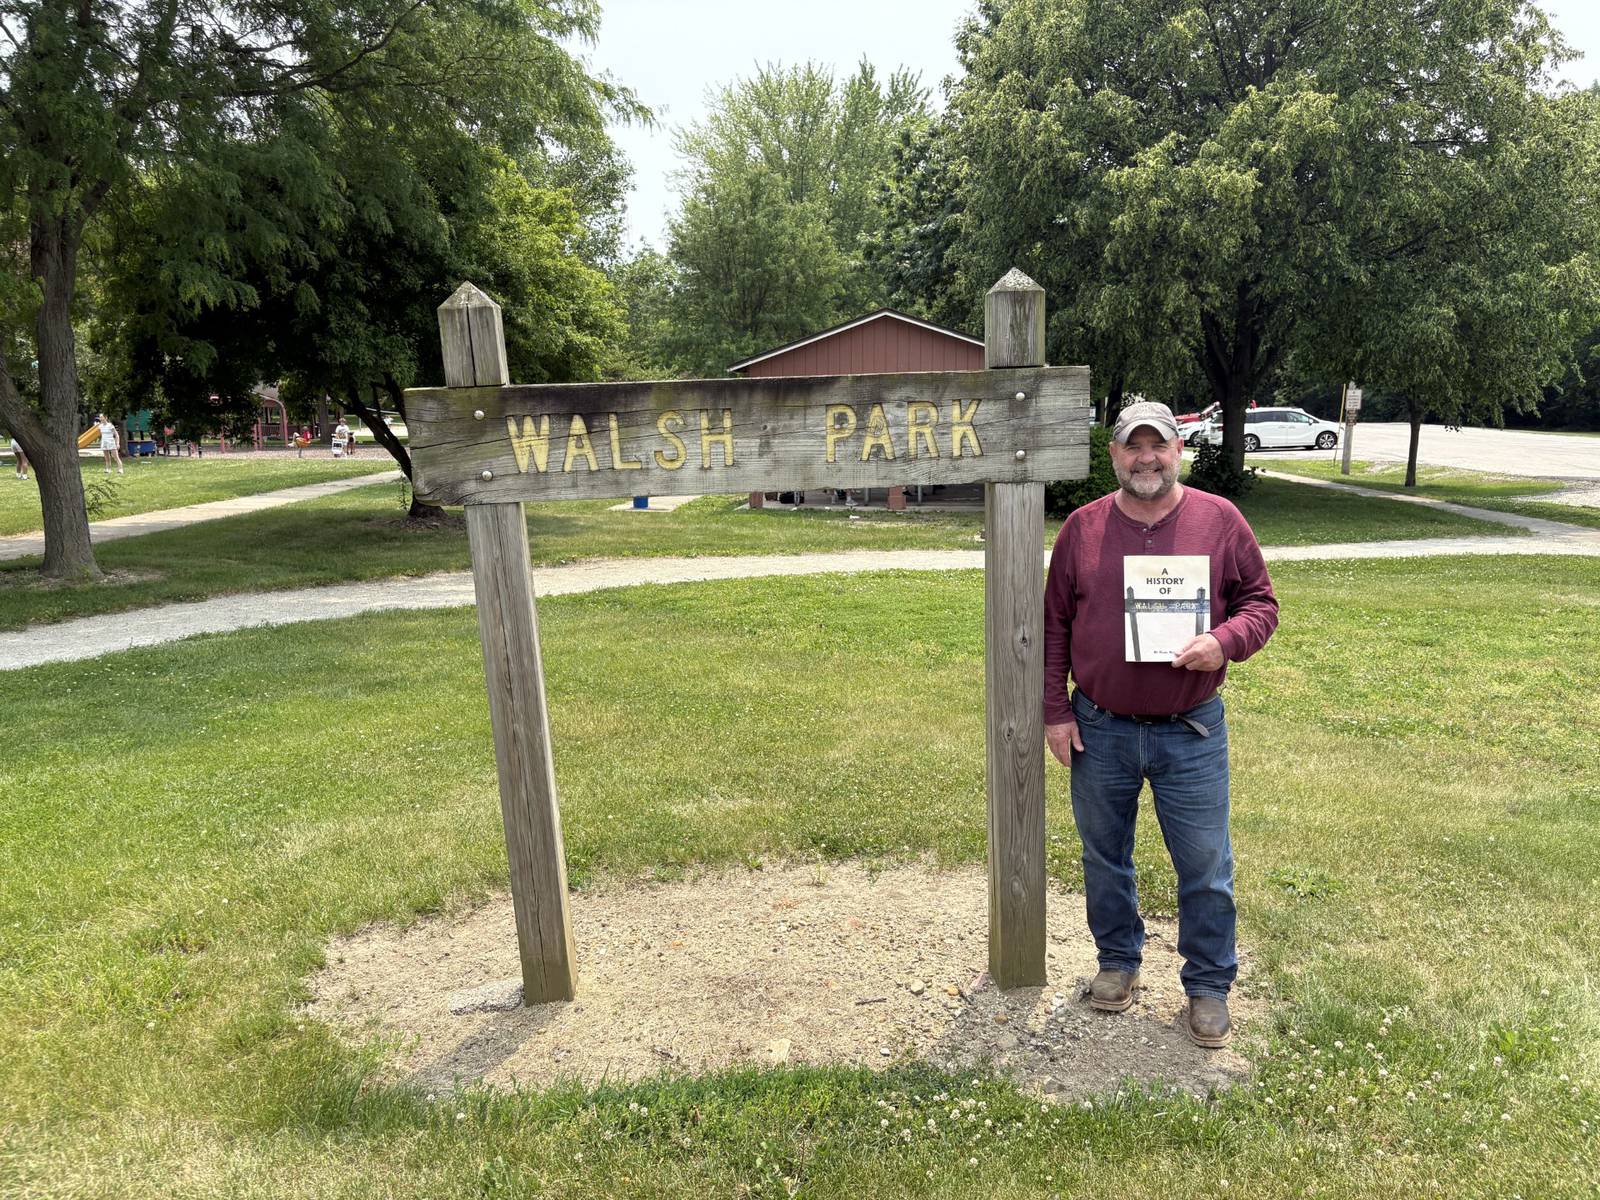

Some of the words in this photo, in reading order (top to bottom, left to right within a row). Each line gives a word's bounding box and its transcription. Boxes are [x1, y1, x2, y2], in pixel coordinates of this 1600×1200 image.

[506, 408, 734, 473] WALSH
[825, 398, 984, 463] PARK
[1161, 567, 1169, 575] A
[1146, 577, 1185, 585] HISTORY
[1159, 587, 1172, 595] OF
